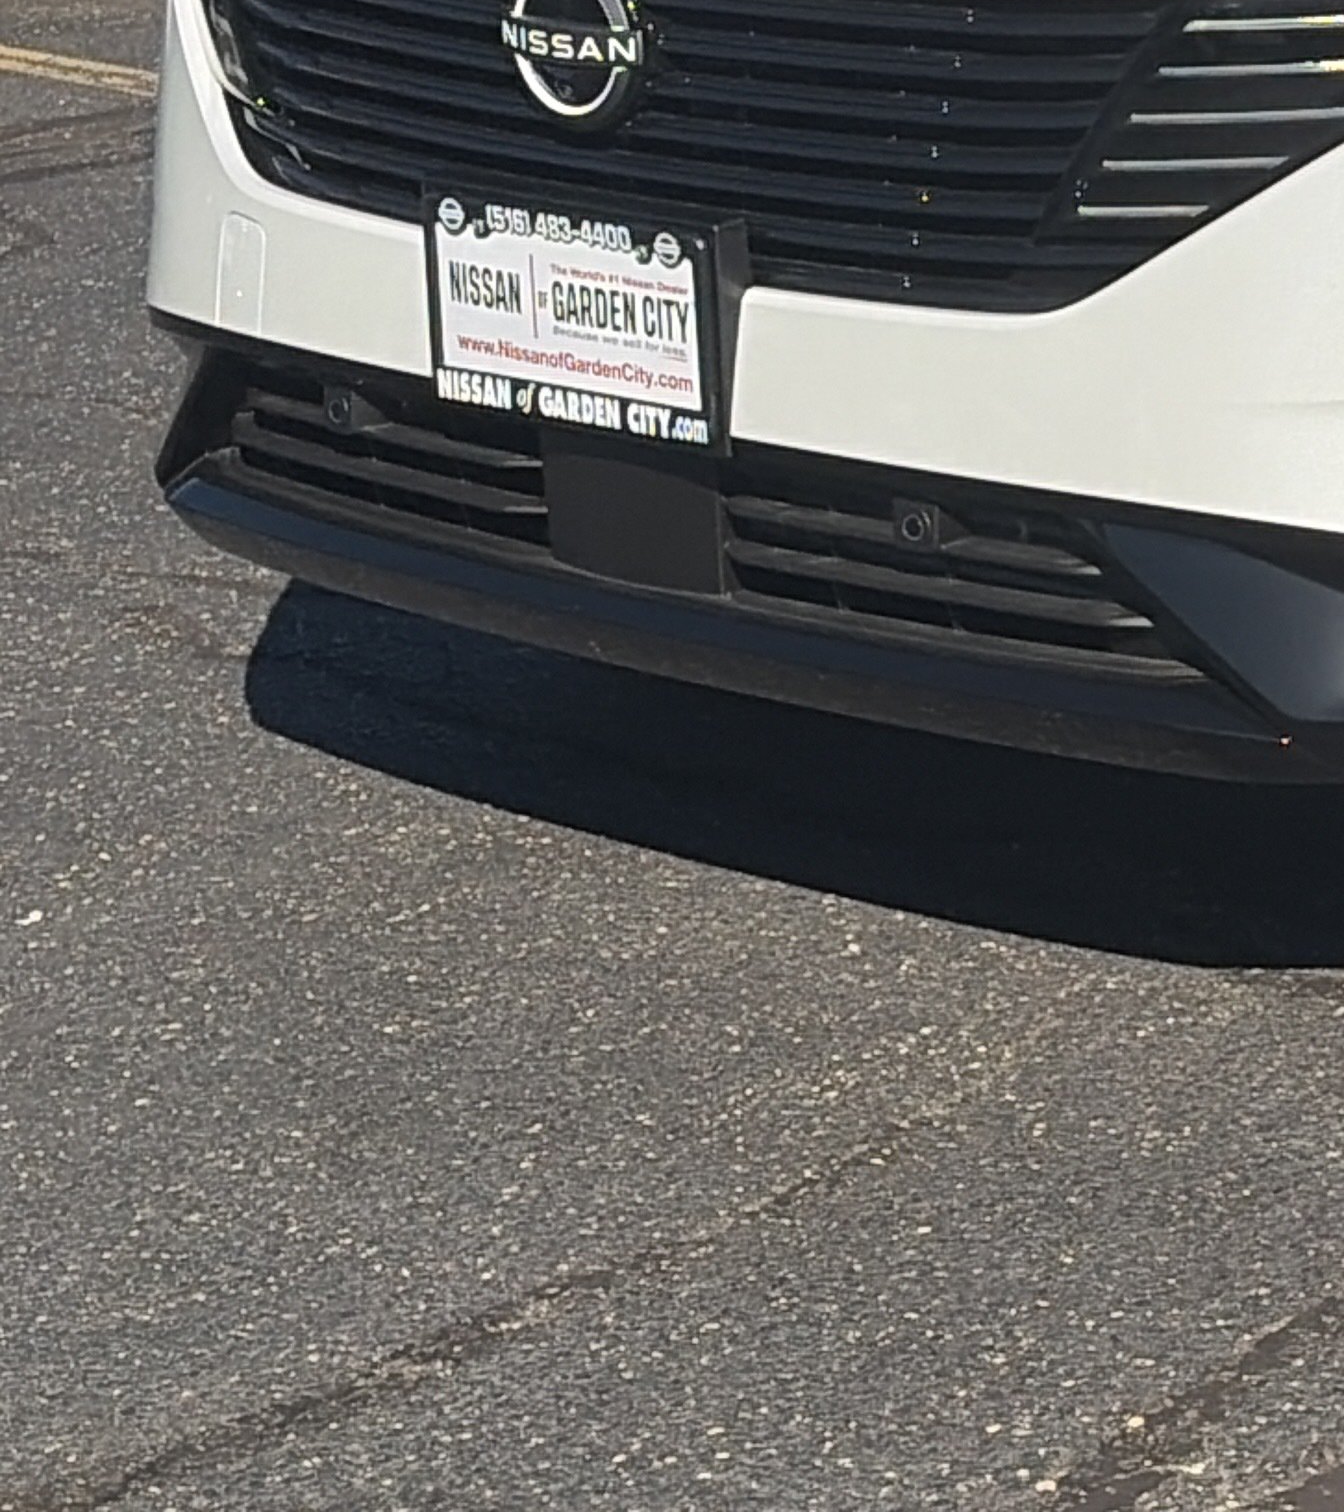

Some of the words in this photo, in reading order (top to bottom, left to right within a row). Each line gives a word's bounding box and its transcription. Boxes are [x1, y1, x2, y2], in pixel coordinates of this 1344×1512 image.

[501, 19, 637, 62] NISSAN
[485, 204, 531, 237] (516)
[535, 212, 633, 252] 483-4400
[448, 260, 522, 315] NISSAN
[551, 281, 637, 335] GARDEN
[642, 295, 689, 343] CITY
[457, 334, 694, 393] www.NissanofGardenCity.com
[437, 368, 512, 410] NISSAN
[516, 383, 536, 415] of
[538, 387, 622, 431] GARDEN
